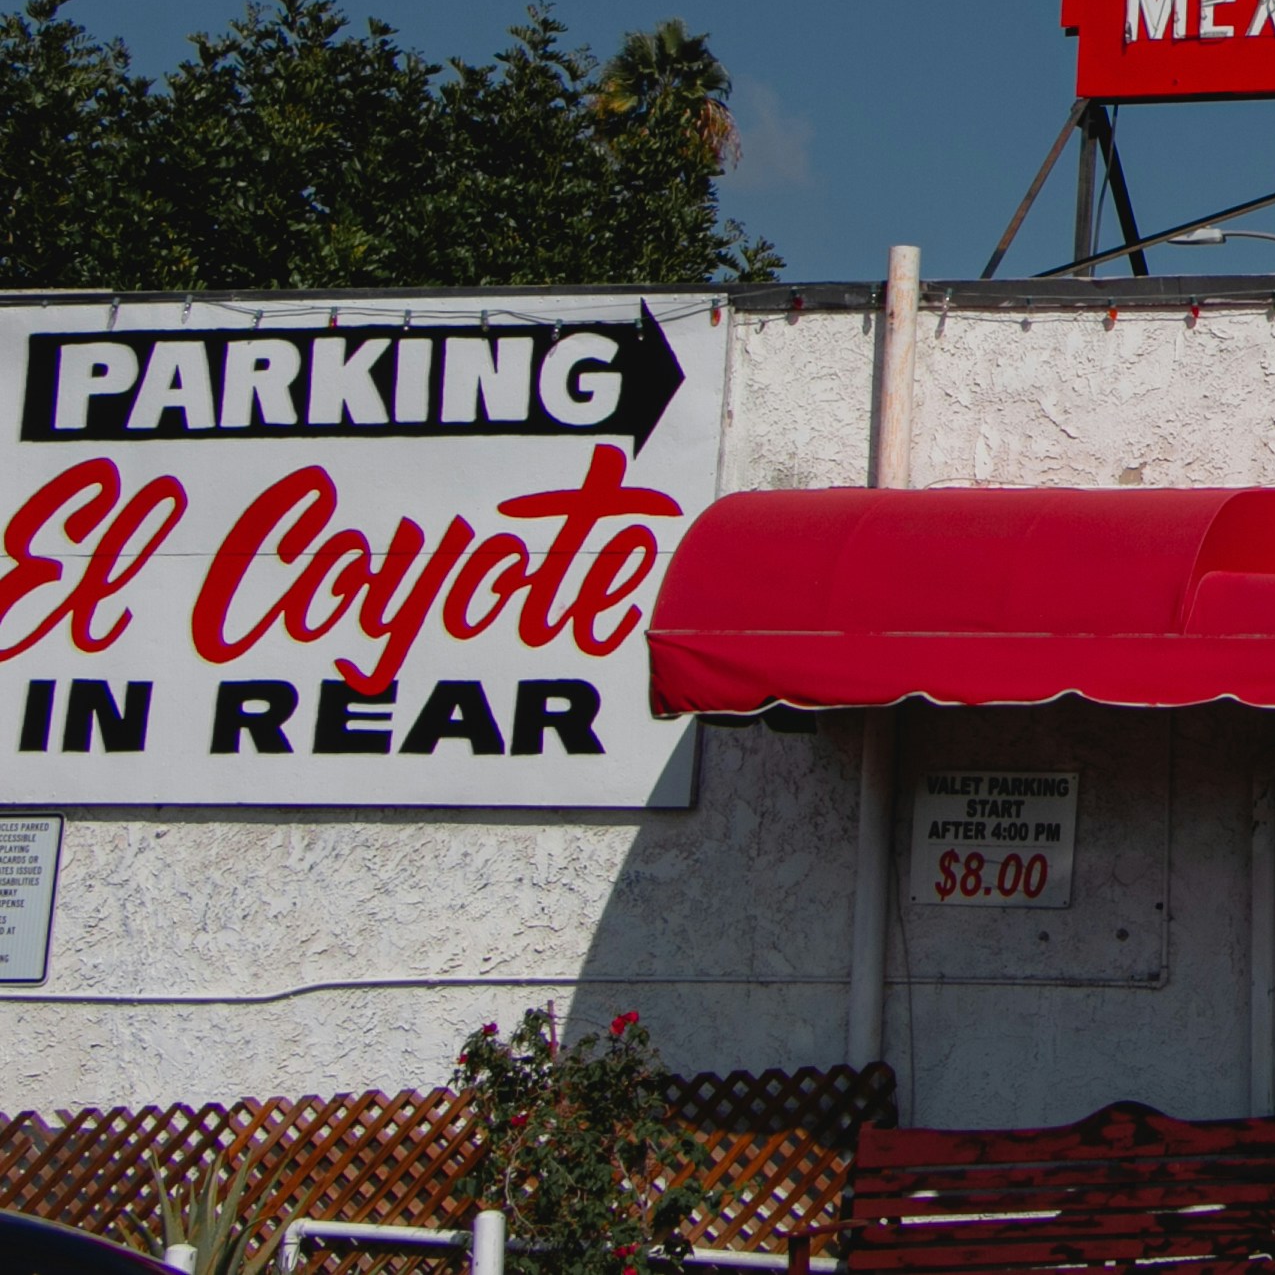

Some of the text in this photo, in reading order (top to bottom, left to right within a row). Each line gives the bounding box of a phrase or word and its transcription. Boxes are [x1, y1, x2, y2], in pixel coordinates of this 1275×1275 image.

[54, 331, 623, 430] PARKING
[0, 443, 684, 696] El Coyote
[19, 679, 606, 754] IN REAR
[927, 776, 1069, 797] VALET PARKING
[21, 822, 50, 832] PARKED
[966, 799, 1025, 818] START
[928, 820, 1061, 842] AFTER 4:00 PM
[935, 848, 1048, 902] $8.00
